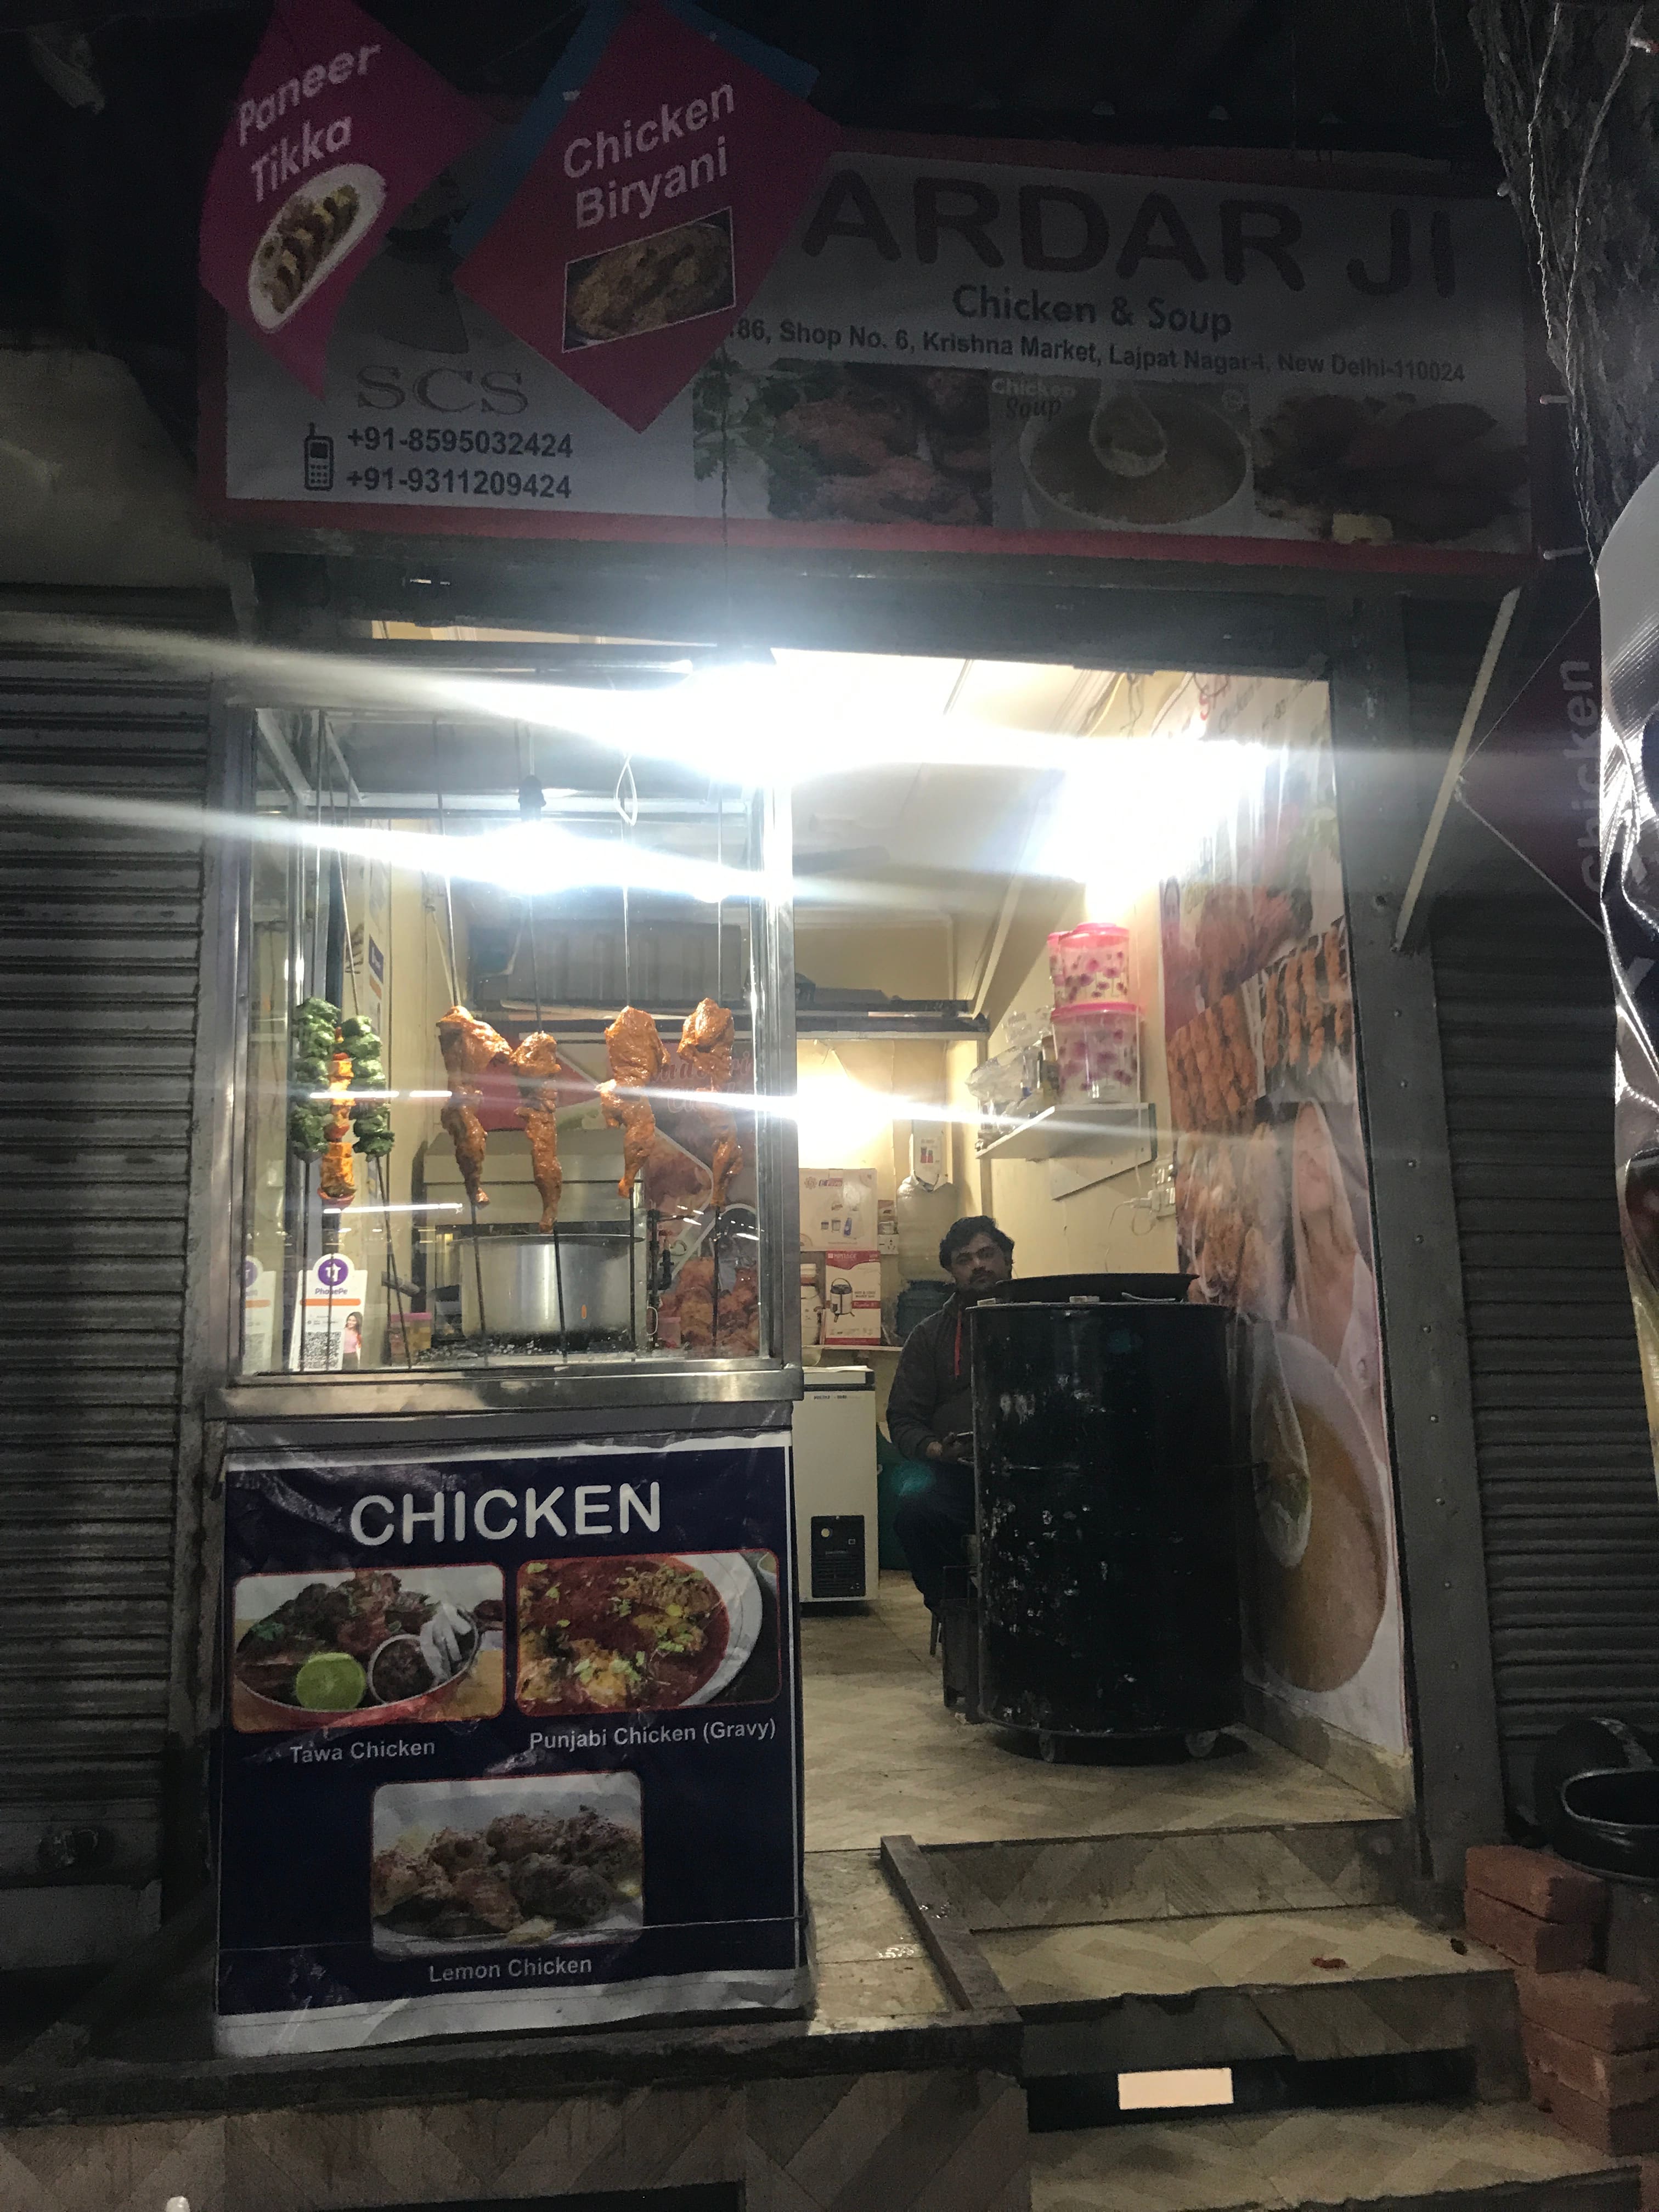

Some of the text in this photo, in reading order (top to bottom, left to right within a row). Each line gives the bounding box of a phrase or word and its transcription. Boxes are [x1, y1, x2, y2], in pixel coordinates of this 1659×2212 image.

[238, 44, 381, 146] Paneer
[250, 116, 352, 201] Tikka
[563, 84, 735, 180] Chicken
[576, 137, 728, 229] Biryani
[801, 169, 1455, 298] ARDAR JI
[953, 284, 1232, 342] Chicken & Soup
[729, 318, 771, 344] 86,
[780, 319, 841, 350] Shop
[849, 325, 887, 349] No.
[895, 330, 915, 352] 6,
[923, 332, 1013, 356] Krishna
[1021, 336, 1101, 366] Market,
[1109, 344, 1177, 369] Lajpat
[1278, 353, 1324, 373] New
[1332, 353, 1465, 382] Delhi-110024
[357, 365, 529, 414] SCS
[1006, 397, 1060, 421] Soup
[348, 426, 573, 458] +91-8595032424
[347, 468, 571, 499] +91-9311209424
[349, 1481, 660, 1545] CHICKEN
[289, 1738, 436, 1764] Tawa Chicken
[529, 1718, 777, 1753] Punjabi Chicken (Gravy)
[429, 1956, 592, 1983] Lemon Chicken
